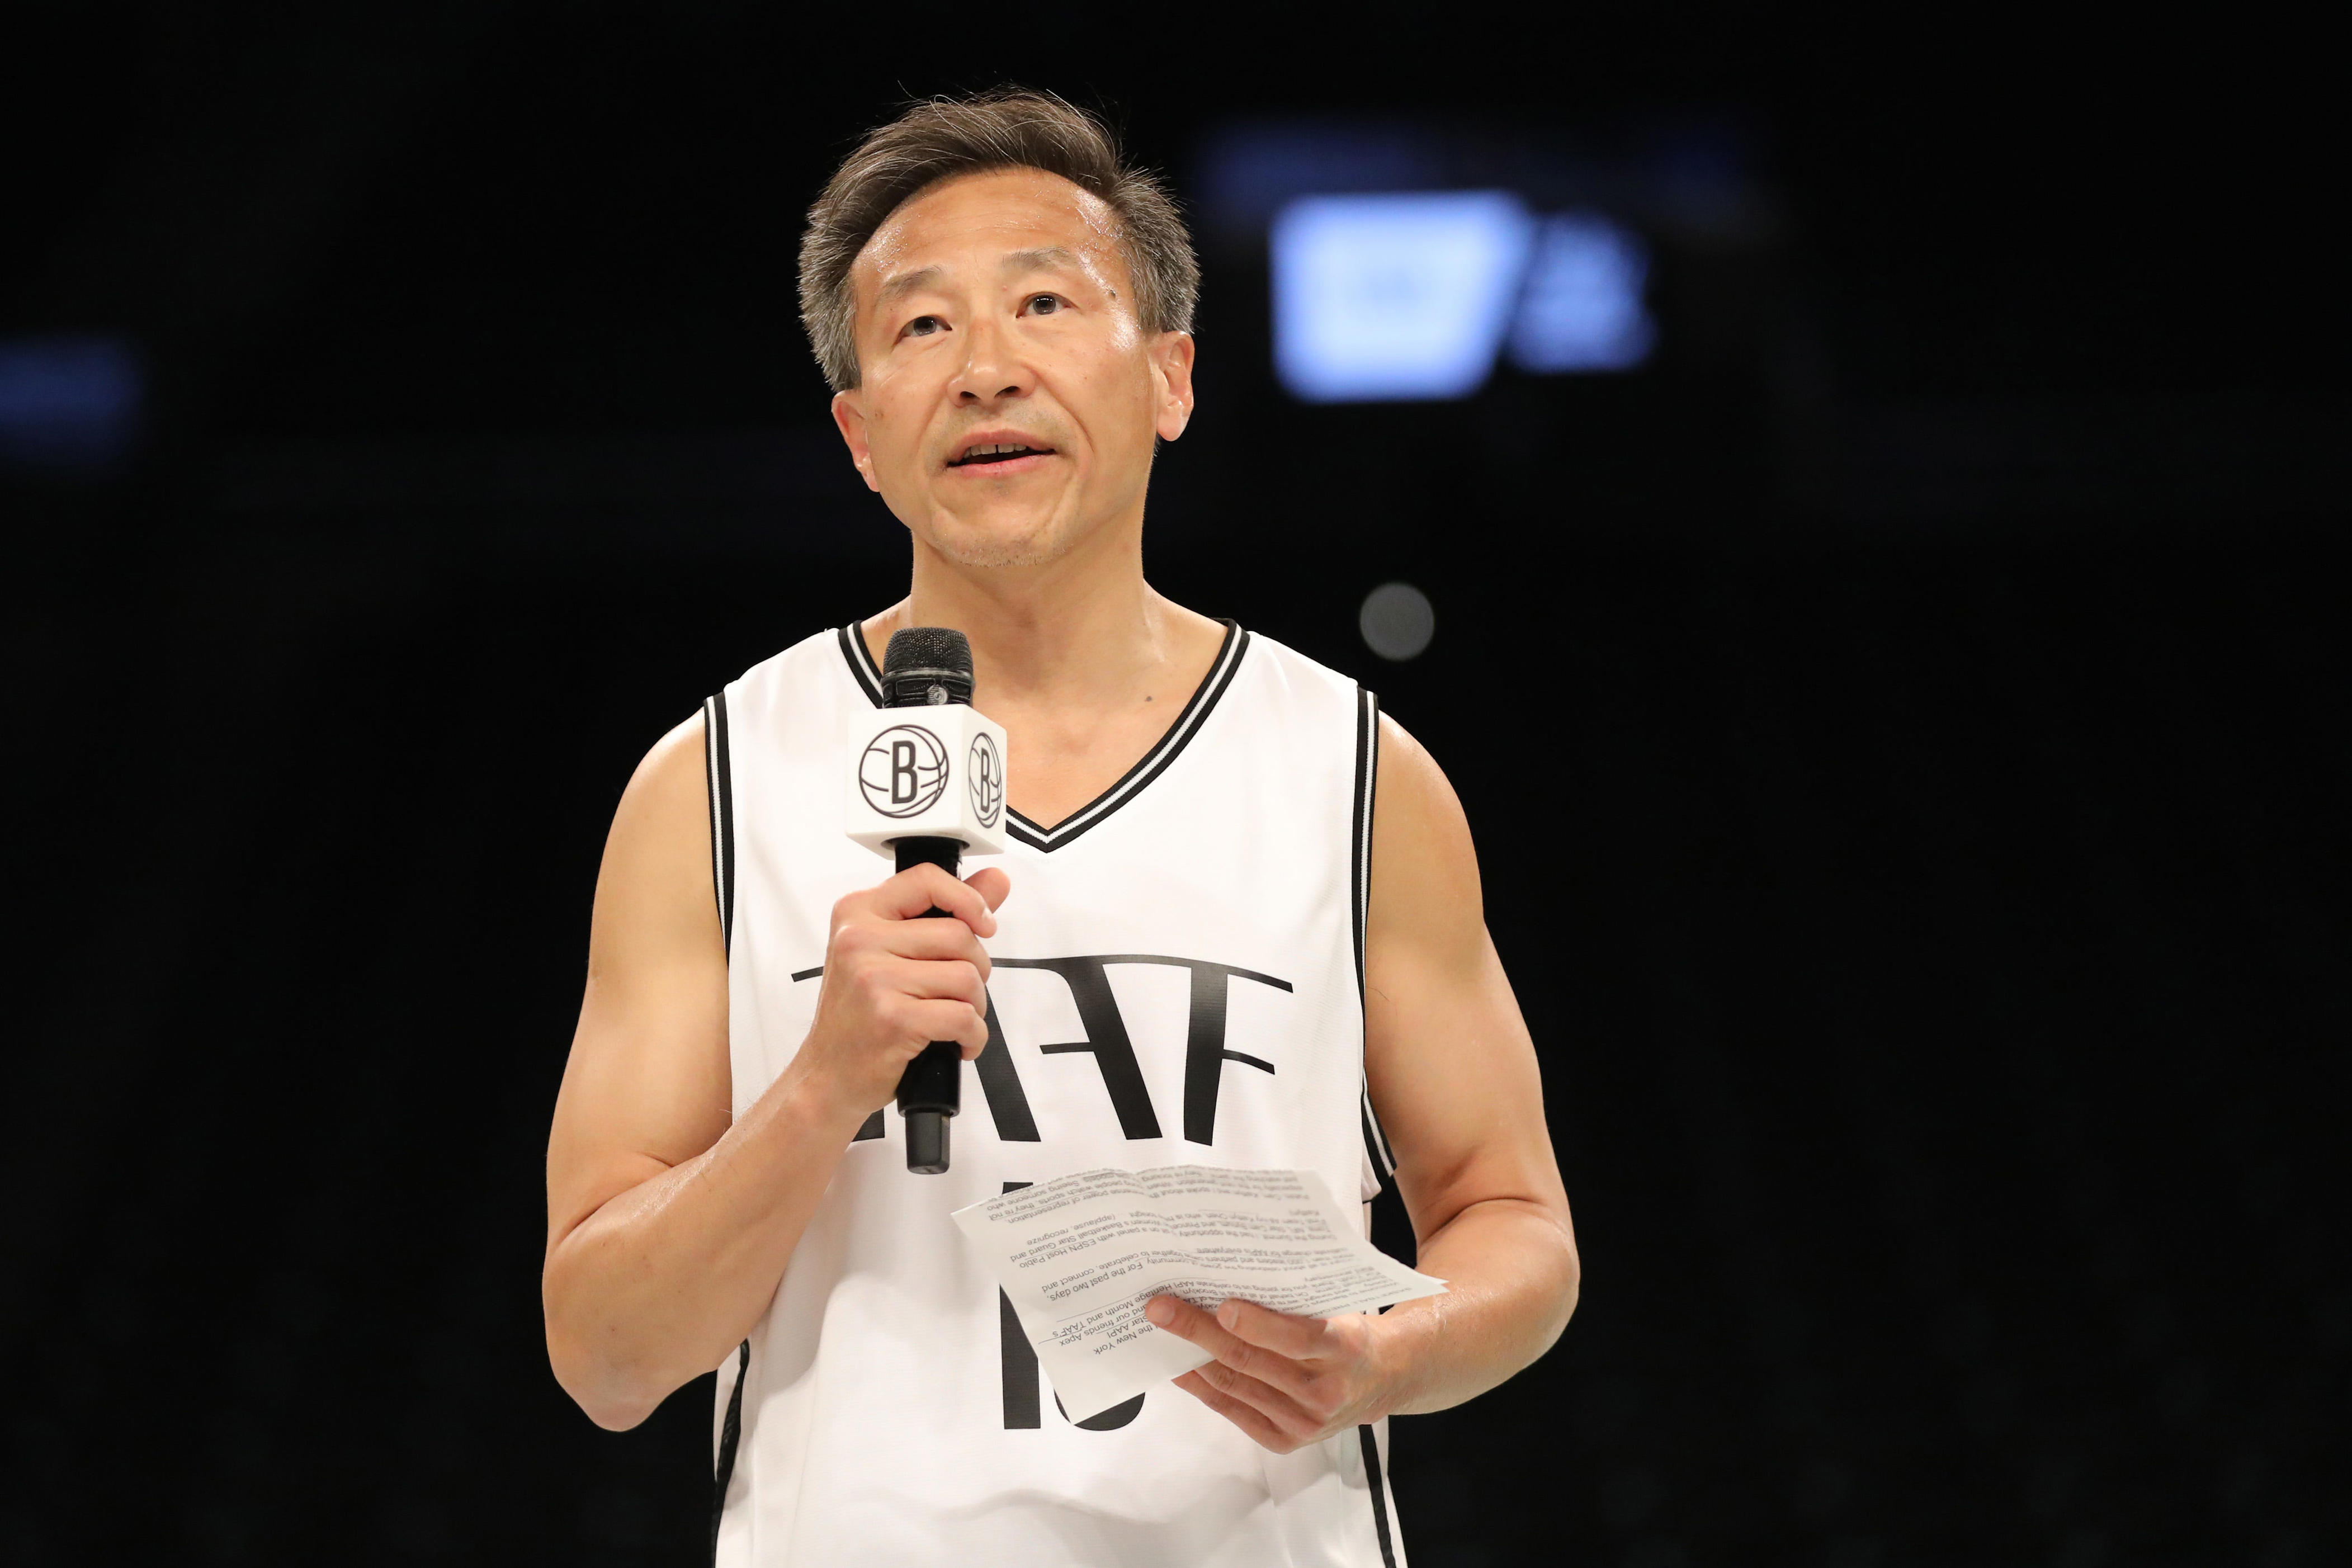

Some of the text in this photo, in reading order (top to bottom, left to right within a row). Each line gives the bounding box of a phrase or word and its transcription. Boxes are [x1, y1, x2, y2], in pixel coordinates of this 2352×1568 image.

[892, 740, 918, 804] B
[980, 747, 990, 814] B
[1007, 1189, 1047, 1206] someone
[986, 1201, 1006, 1211] who
[988, 1211, 1003, 1221] not
[1027, 1227, 1069, 1246] recognize
[1077, 1222, 1123, 1239] Basketball
[1097, 1232, 1116, 1242] with
[1057, 1235, 1077, 1245] Star
[1068, 1238, 1097, 1253] ESPN
[1028, 1241, 1056, 1257] Guard
[1045, 1248, 1068, 1260] Host
[1009, 1251, 1027, 1263] and
[1019, 1255, 1045, 1269] Pablo
[1111, 1267, 1126, 1278] the
[1127, 1261, 1143, 1271] For
[1059, 1268, 1095, 1286] connect
[1090, 1272, 1109, 1286] past
[1173, 1280, 1194, 1288] AAPI
[1041, 1281, 1059, 1293] and
[1072, 1282, 1089, 1293] two
[1134, 1283, 1172, 1303] Heritage
[1046, 1288, 1071, 1302] days,
[1105, 1301, 1134, 1317] Month
[1086, 1312, 1104, 1324] and
[1115, 1312, 1130, 1324] our
[1052, 1320, 1087, 1338] TAAF's
[1083, 1319, 1115, 1337] friends
[1106, 1323, 1130, 1338] AAPI
[1138, 1323, 1154, 1334] the
[1059, 1332, 1083, 1347] Apex
[1116, 1331, 1137, 1345] New
[1093, 1342, 1116, 1356] York
